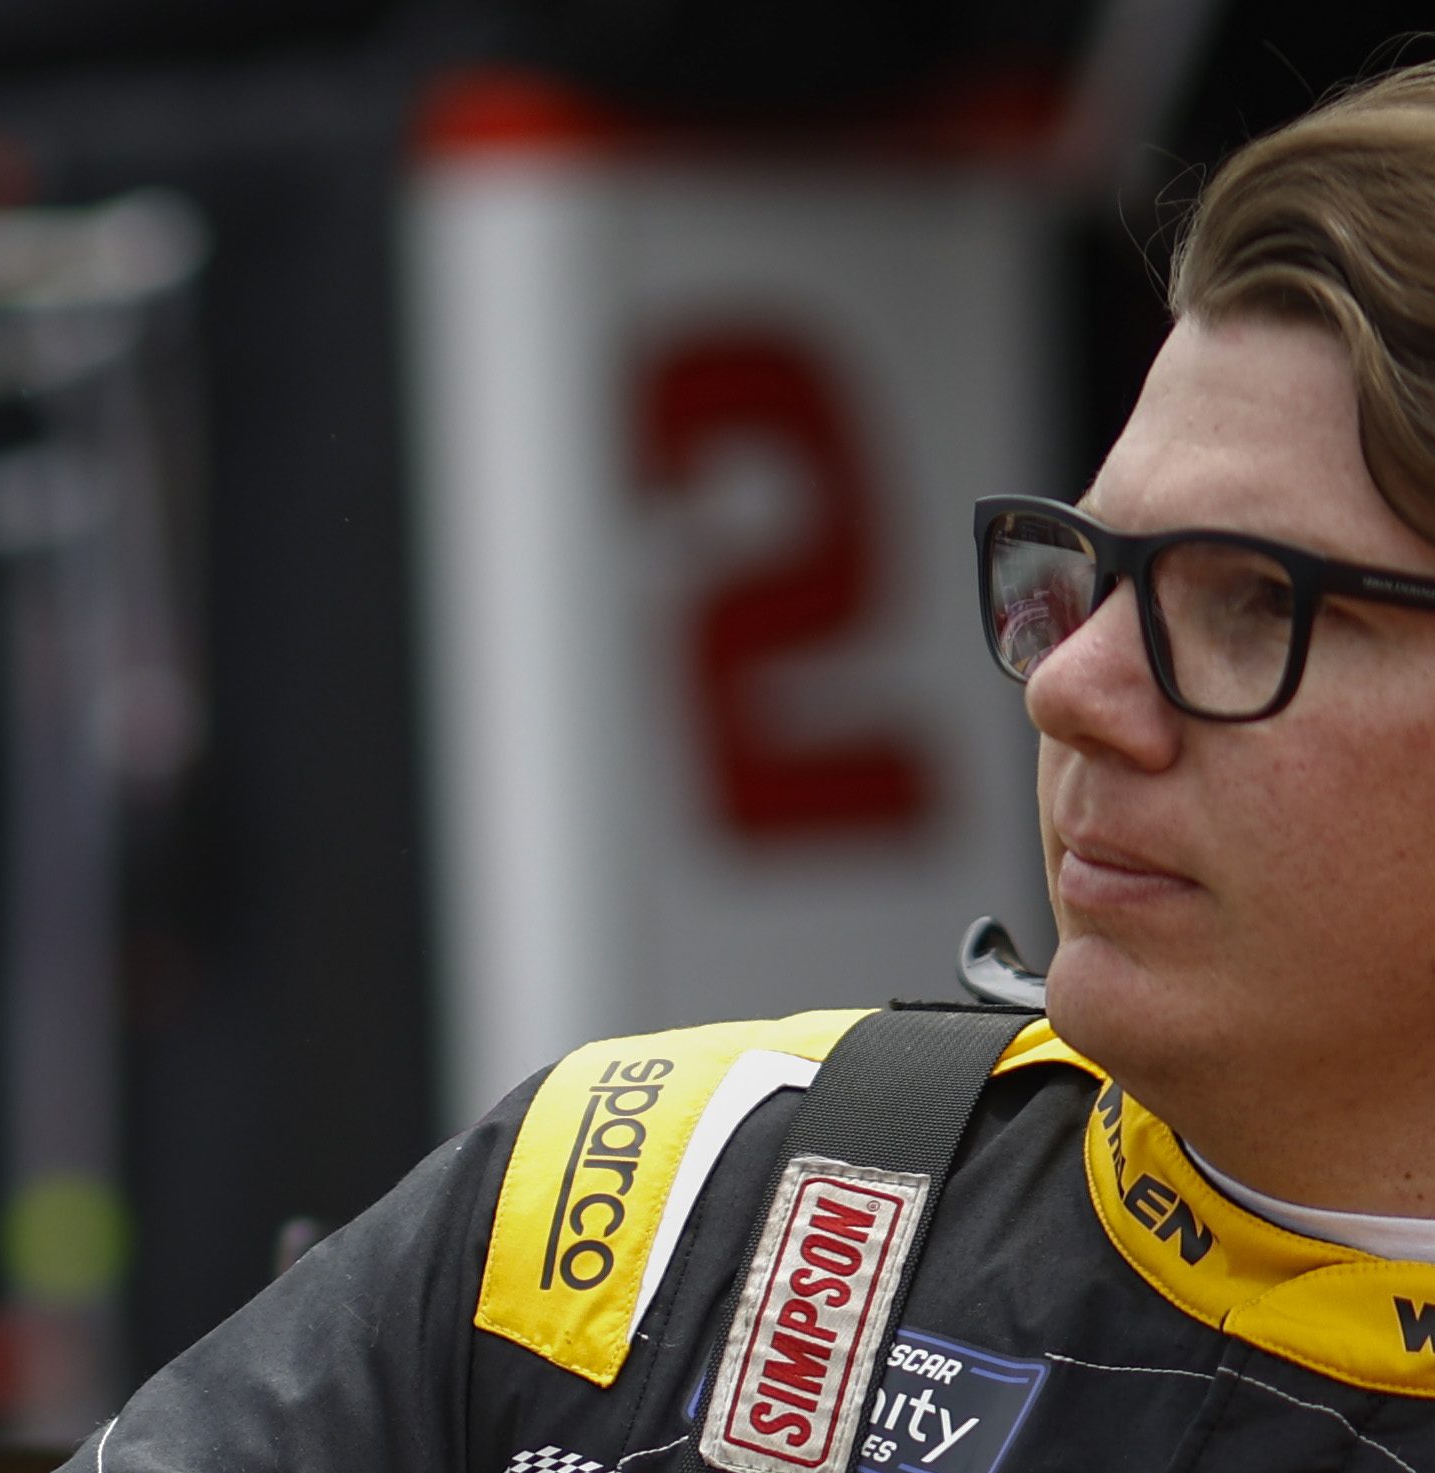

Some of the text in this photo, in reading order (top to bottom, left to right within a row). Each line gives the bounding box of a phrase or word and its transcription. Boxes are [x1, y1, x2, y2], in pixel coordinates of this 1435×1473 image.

[620, 325, 935, 845] 2
[540, 1057, 675, 1291] sparco
[749, 1194, 876, 1450] SIMPSON
[887, 1343, 963, 1385] SCAR
[860, 1434, 898, 1463] ES
